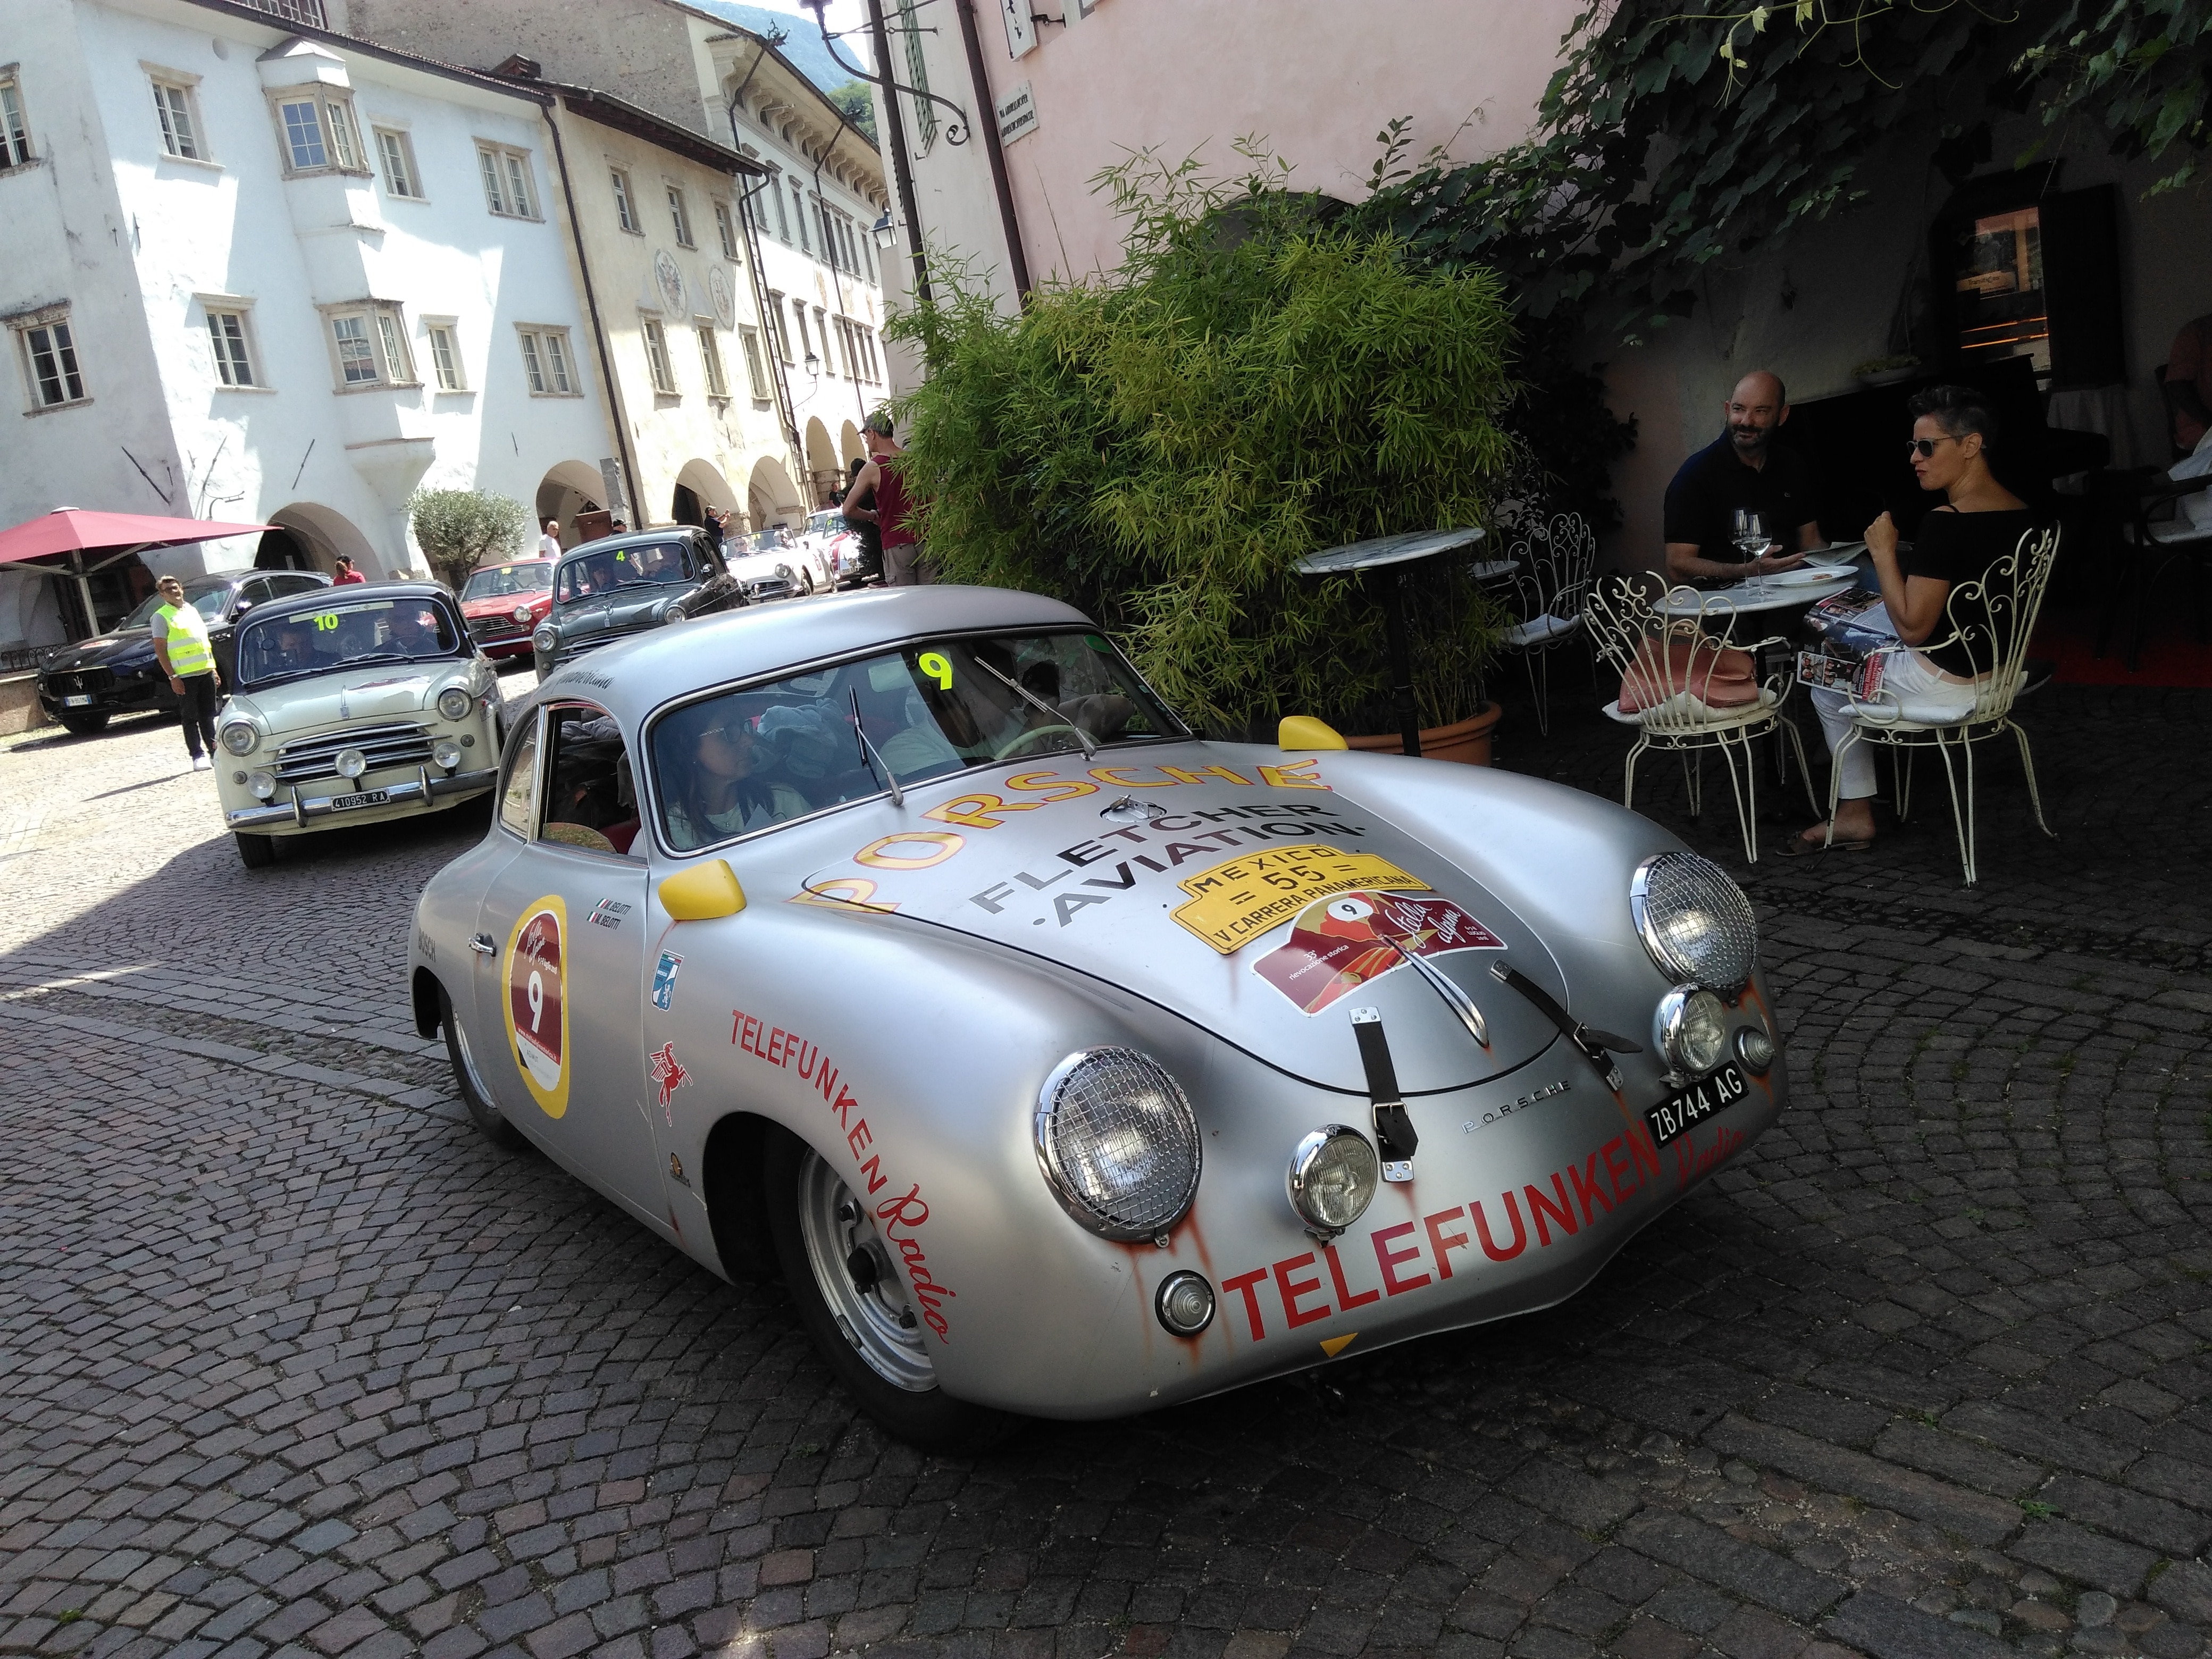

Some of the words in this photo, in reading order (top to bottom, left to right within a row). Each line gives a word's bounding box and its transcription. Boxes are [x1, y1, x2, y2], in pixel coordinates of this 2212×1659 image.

[616, 550, 625, 562] 4
[314, 614, 338, 631] 10
[919, 652, 952, 691] 9
[335, 795, 367, 808] 410952
[372, 792, 385, 802] RA
[784, 759, 1334, 914] PORSCHE
[968, 804, 1342, 916] FLETCHER
[1192, 848, 1336, 893] MEXICO
[600, 915, 621, 930] BELOTTI
[609, 902, 632, 915] BELOTTI
[1228, 893, 1304, 936] CARRERA
[1302, 875, 1415, 900] PANAMERICANA
[1341, 903, 1359, 916] 9
[418, 927, 436, 962] BOSCH
[1289, 955, 1328, 981] rievocazione
[1327, 945, 1350, 958] storica
[528, 970, 542, 1034] 9
[1461, 1080, 1571, 1135] PORSCHE
[1650, 1086, 1711, 1141] ZB744
[1715, 1068, 1742, 1103] AG
[731, 1009, 888, 1195] TELEFUNKEN
[876, 1183, 957, 1345] Radio
[1221, 1119, 1662, 1342] TELEFUNKEN
